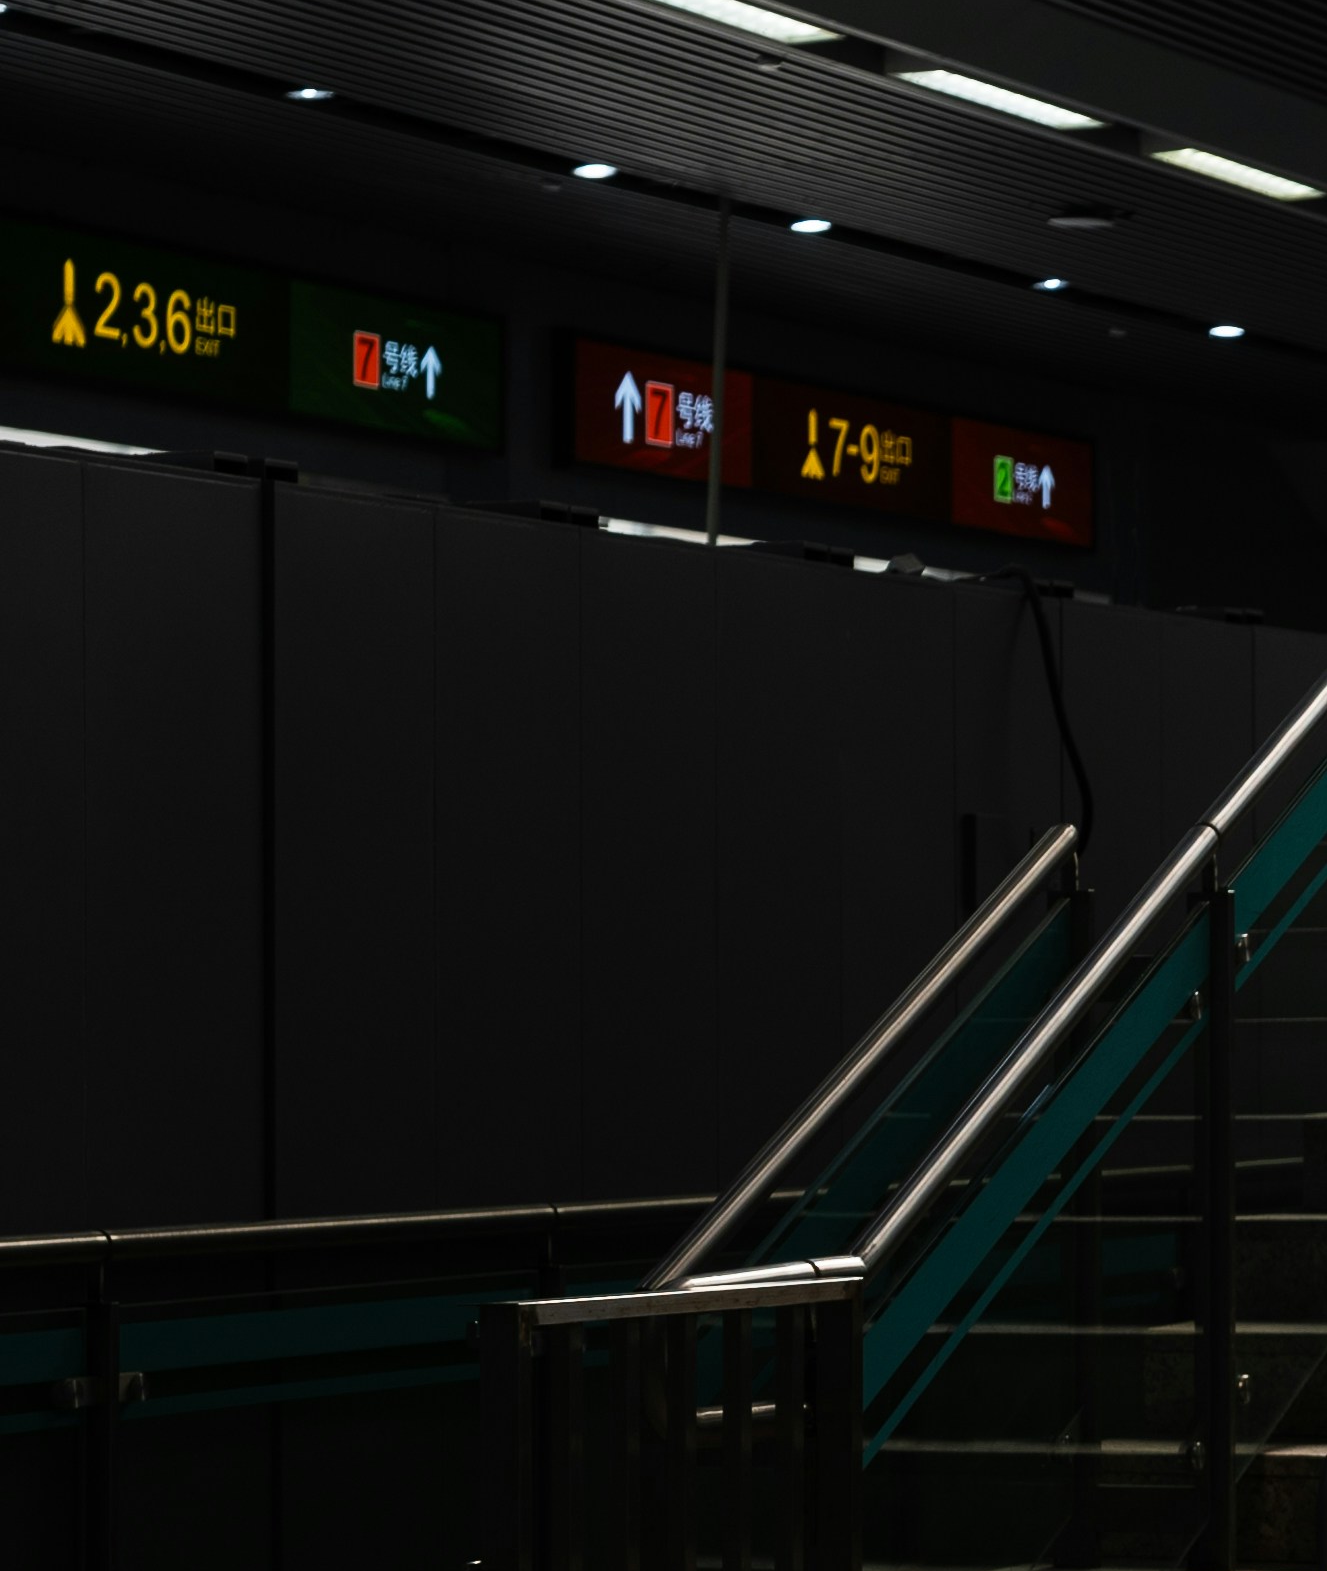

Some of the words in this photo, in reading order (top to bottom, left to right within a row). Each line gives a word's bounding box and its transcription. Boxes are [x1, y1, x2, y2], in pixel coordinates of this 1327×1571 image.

[93, 271, 193, 356] 2,3,6
[195, 295, 237, 339] 出口
[358, 337, 374, 381] 7
[652, 390, 668, 437] 7
[828, 416, 880, 484] 7-9
[880, 429, 912, 466] 出口
